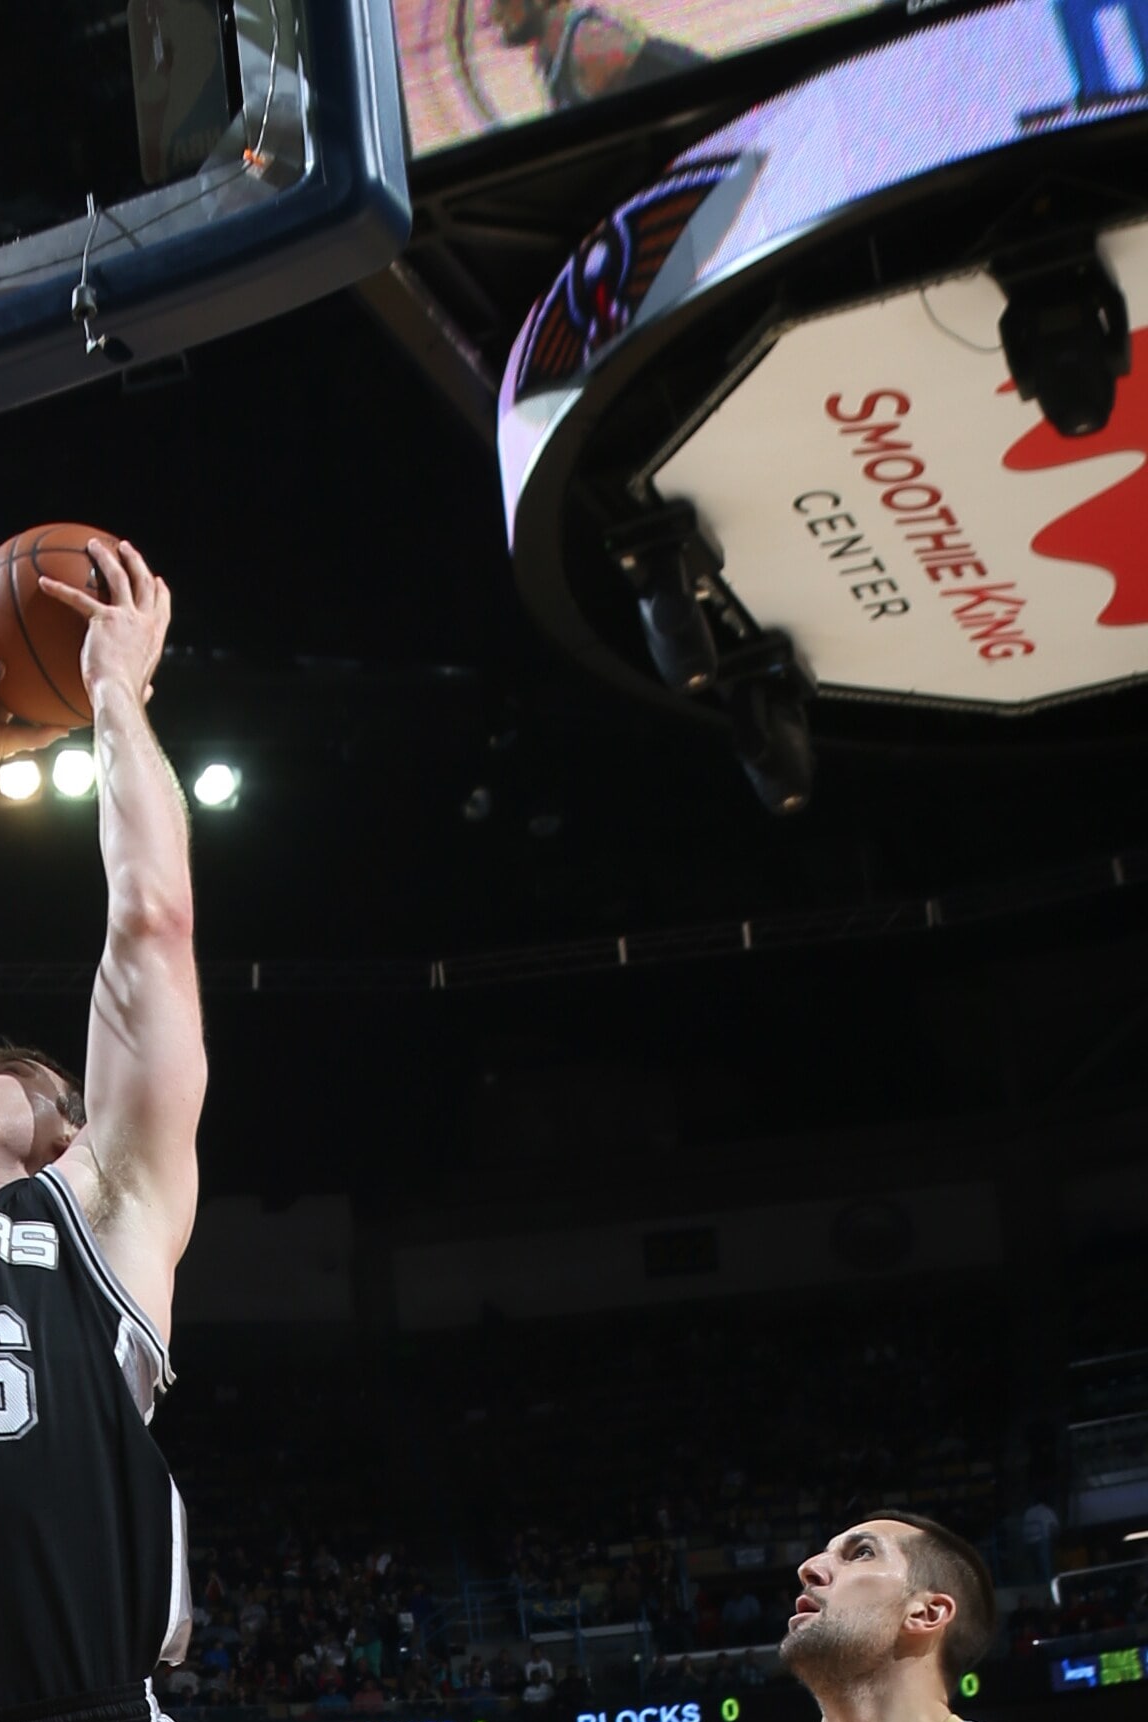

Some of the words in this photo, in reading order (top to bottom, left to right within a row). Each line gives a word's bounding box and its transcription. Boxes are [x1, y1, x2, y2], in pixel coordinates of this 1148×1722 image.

[825, 388, 988, 583] SMOOTHIE
[793, 490, 910, 621] CENTER
[721, 1697, 740, 1722] 0
[960, 1672, 980, 1698] 0
